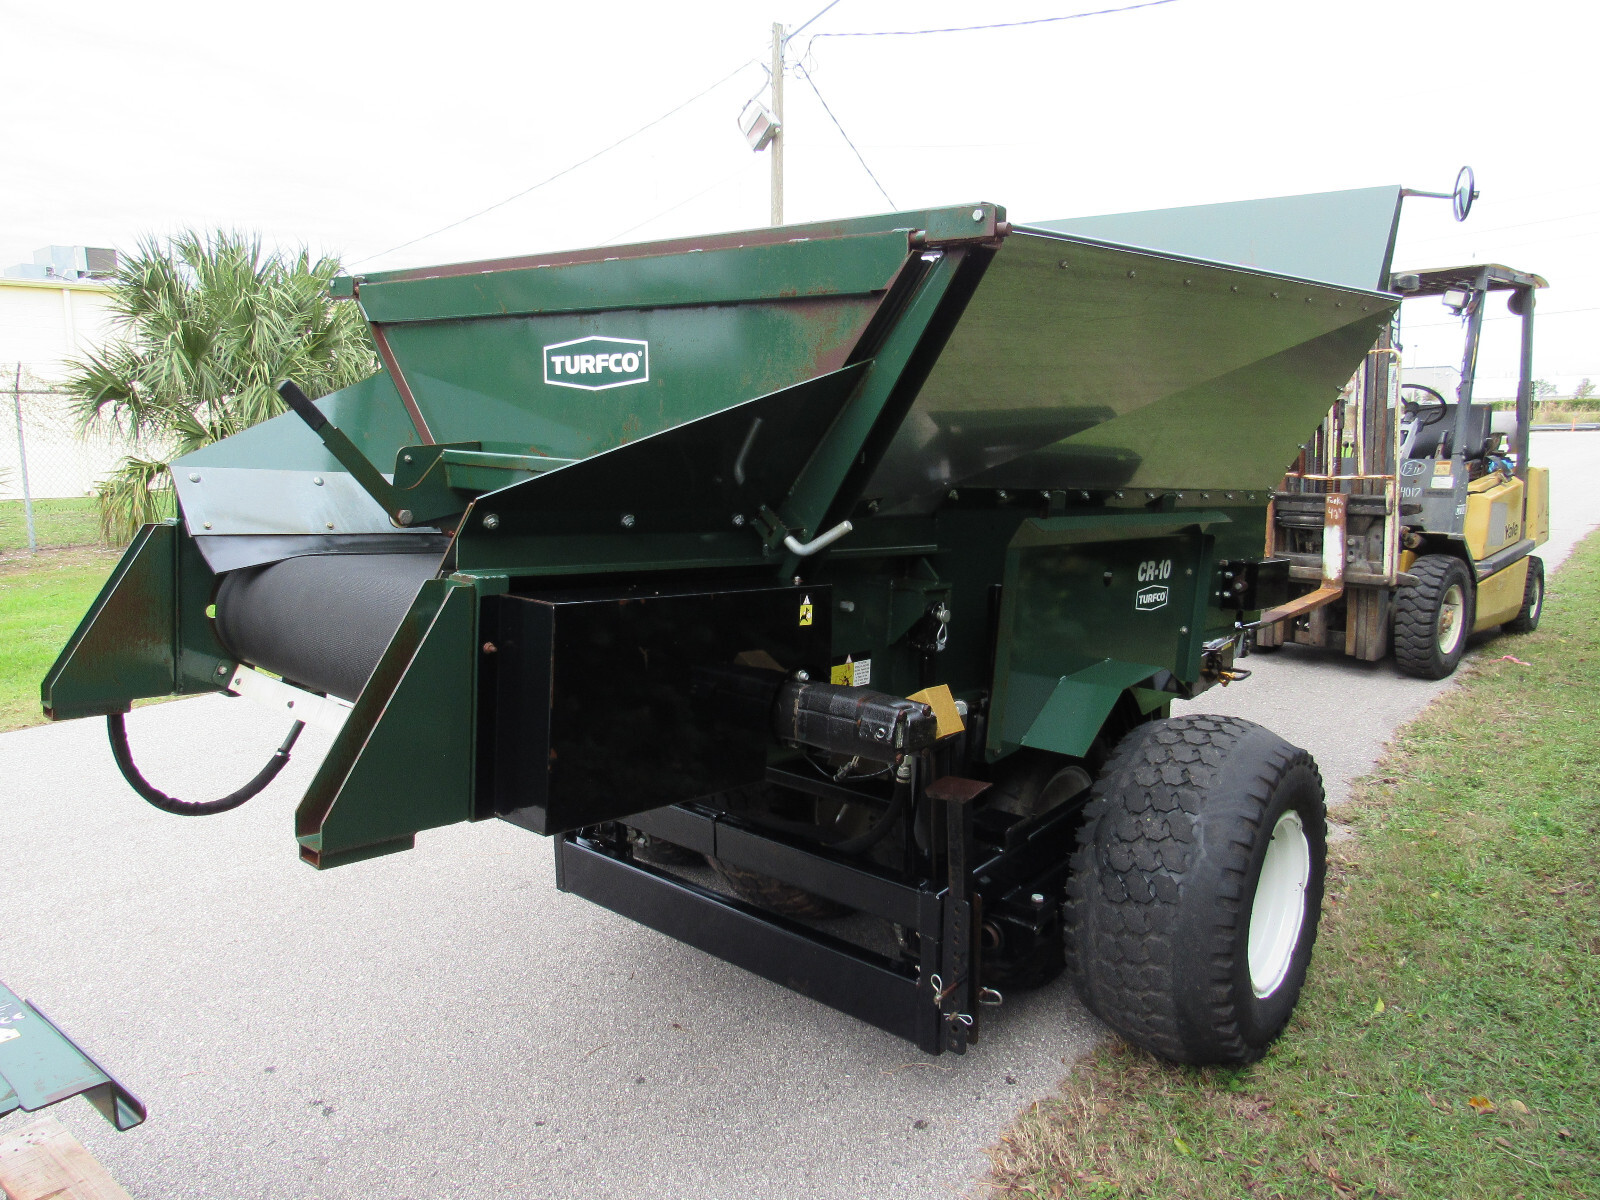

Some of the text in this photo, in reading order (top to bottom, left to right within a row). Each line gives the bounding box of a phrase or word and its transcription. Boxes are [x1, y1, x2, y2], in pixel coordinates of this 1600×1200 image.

[1400, 487, 1421, 498] 4017
[1138, 560, 1171, 582] CR-10
[1139, 592, 1165, 604] TURFCO
